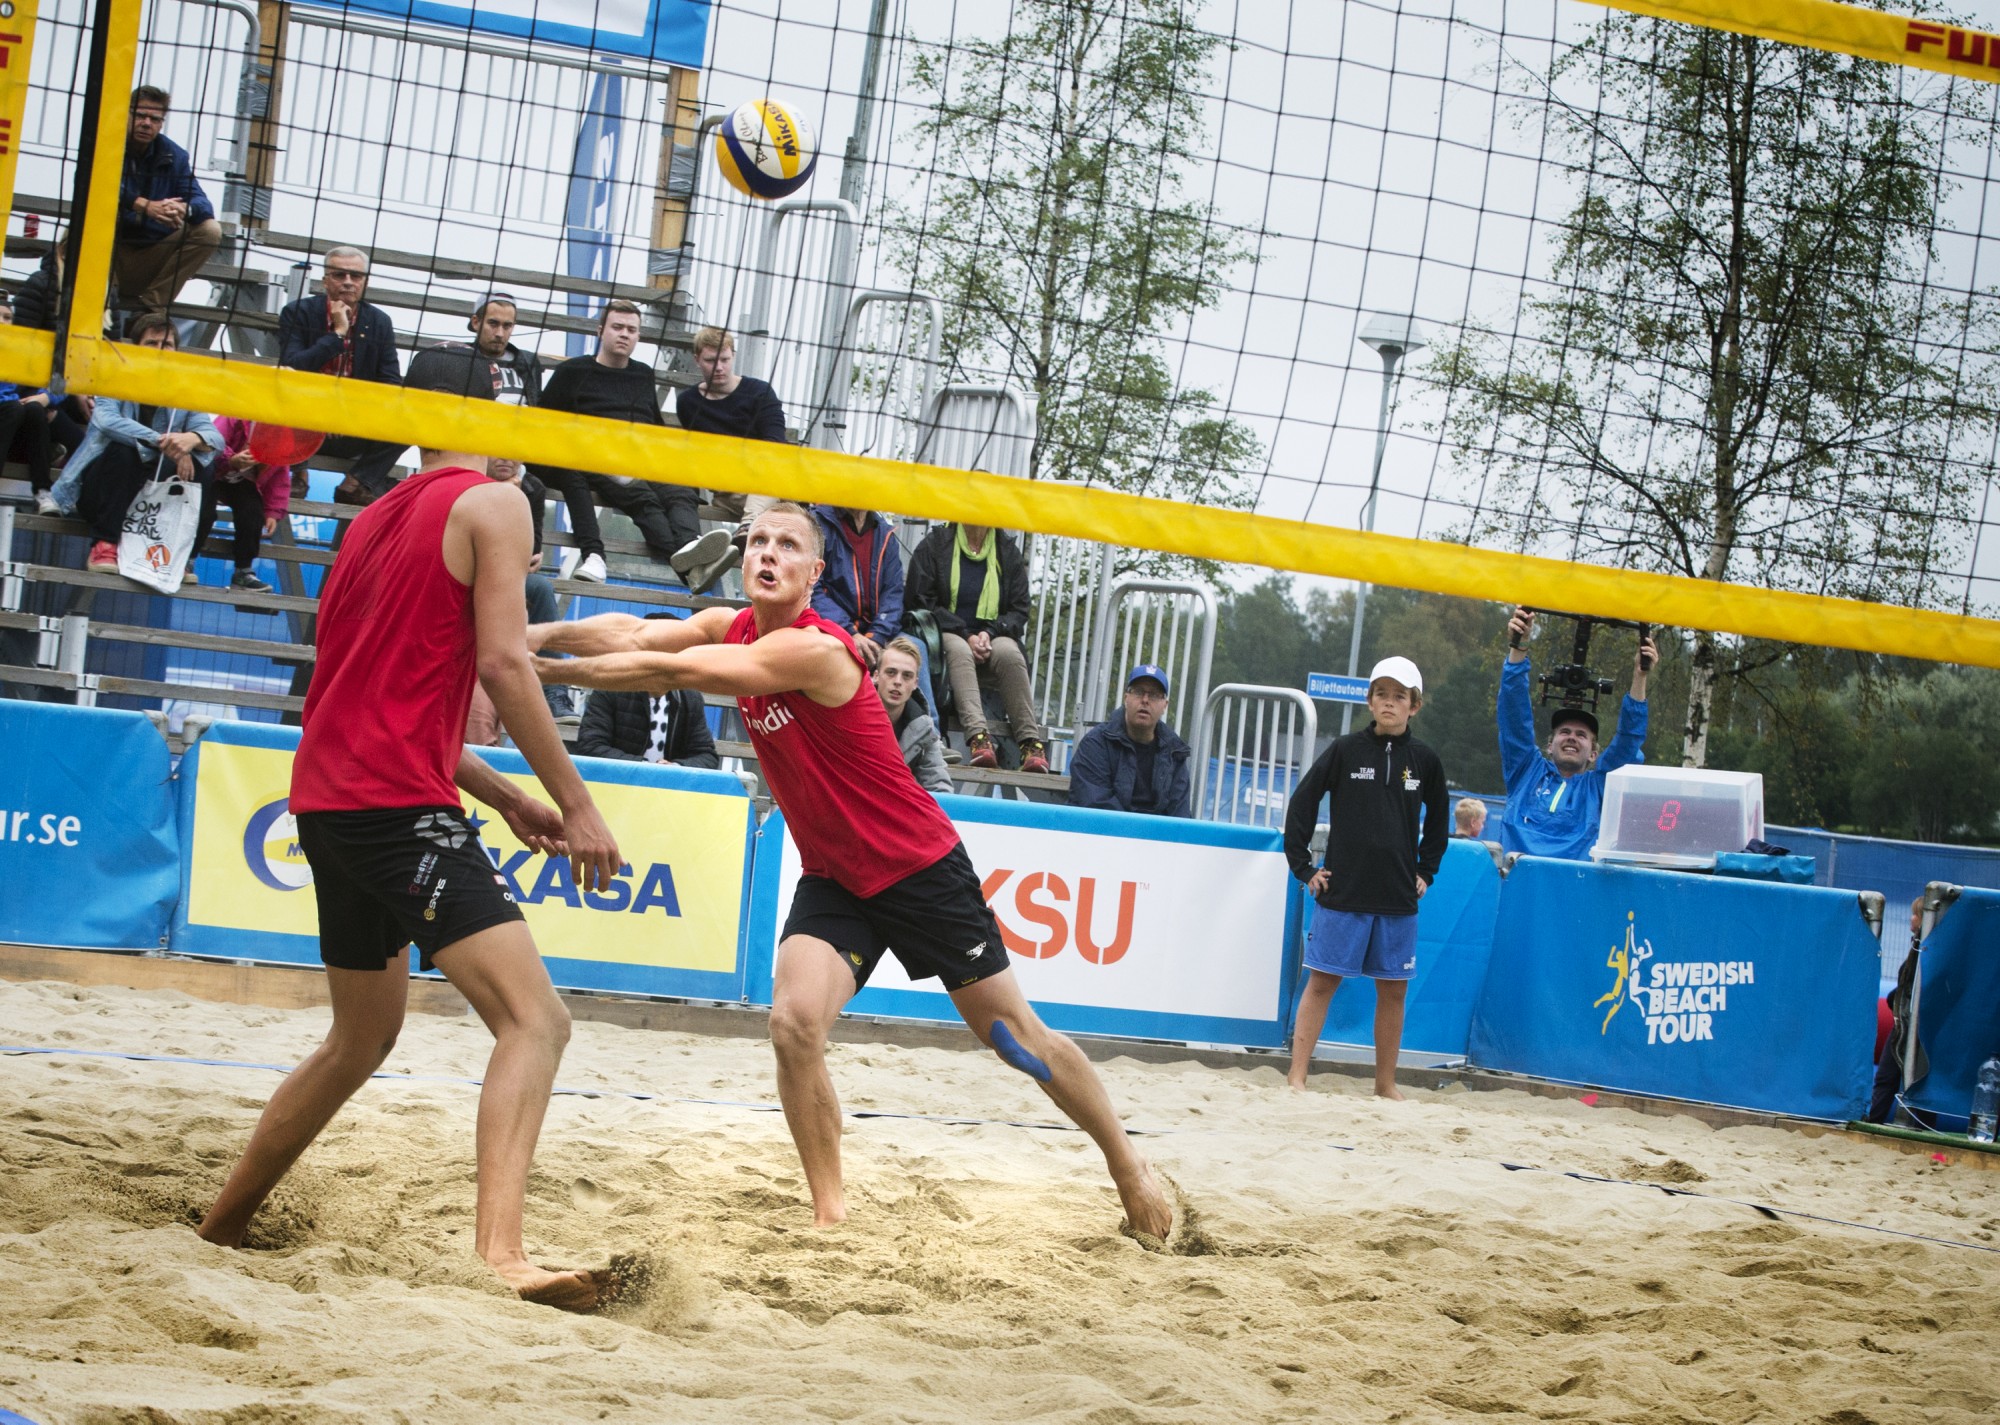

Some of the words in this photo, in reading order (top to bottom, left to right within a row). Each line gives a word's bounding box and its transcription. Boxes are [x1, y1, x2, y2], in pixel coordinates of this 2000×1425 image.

[136, 500, 161, 514] OM
[1657, 800, 1681, 832] 8
[1651, 961, 1754, 987] SWEDISH
[1649, 986, 1726, 1015] BEACH
[1645, 1013, 1713, 1045] TOUR
